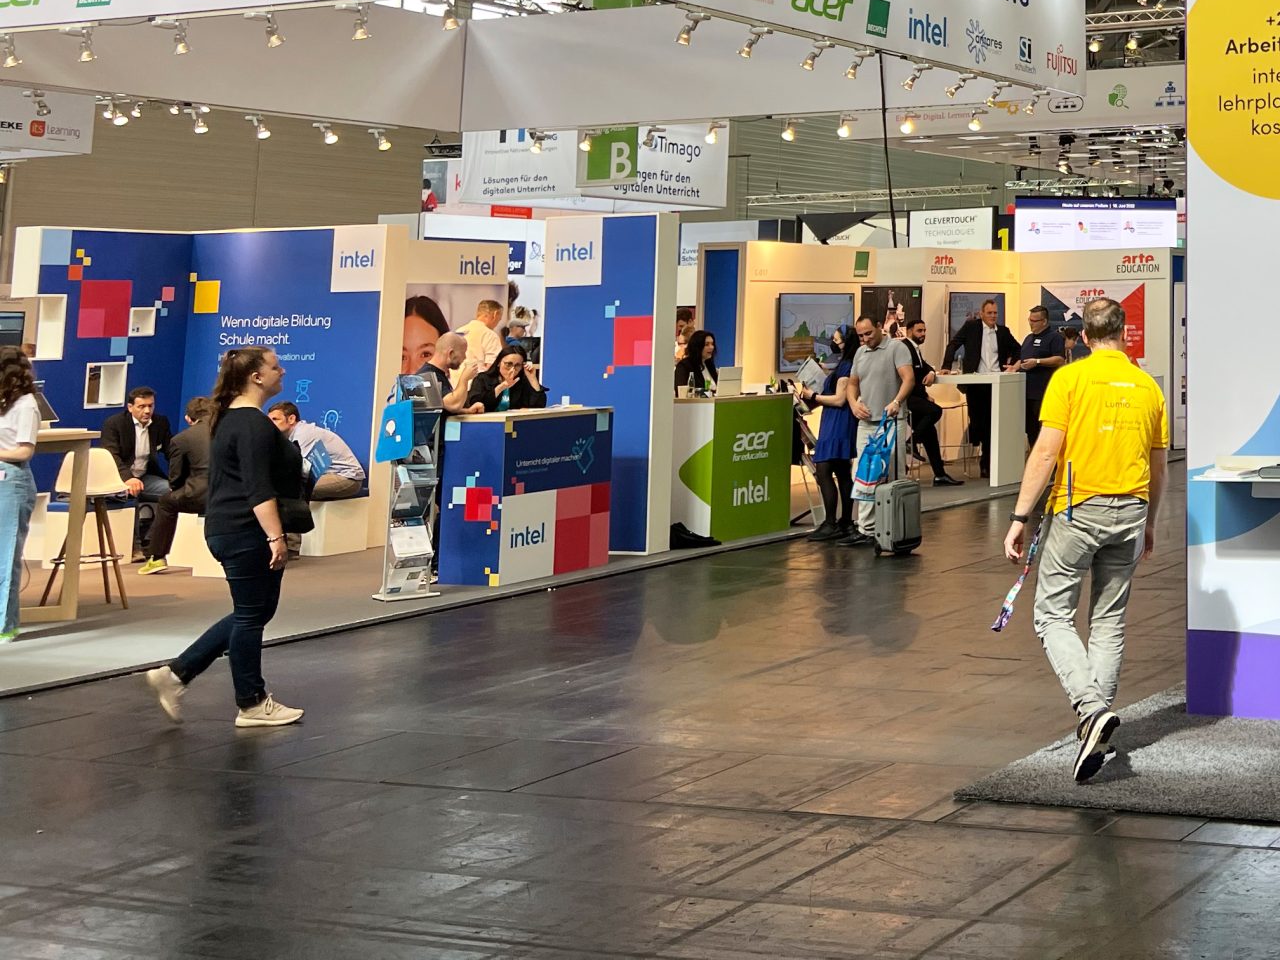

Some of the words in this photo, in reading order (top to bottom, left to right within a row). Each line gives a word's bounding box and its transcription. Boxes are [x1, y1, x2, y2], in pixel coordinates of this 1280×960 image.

[908, 8, 947, 47] intel
[1046, 45, 1077, 77] FUJITSU
[0, 121, 23, 130] EKE
[657, 135, 701, 163] Timago
[610, 141, 632, 180] B
[483, 176, 518, 185] Lösungen
[520, 174, 532, 182] für
[533, 174, 548, 182] den
[660, 170, 673, 182] für
[675, 172, 691, 183] den
[482, 186, 516, 196] digitalen
[517, 184, 556, 193] Unterricht
[656, 184, 700, 198] Unterricht
[924, 216, 976, 225] CLEVERTOUCH
[339, 248, 374, 269] intel
[556, 241, 593, 262] intel
[1122, 253, 1155, 264] arte
[460, 254, 495, 276] intel
[930, 265, 957, 275] EDUCATION
[1116, 263, 1160, 274] EDUCATION
[221, 315, 251, 328] Wenn
[252, 315, 289, 330] digitale
[291, 314, 332, 329] Bildung
[219, 333, 255, 346] Schule
[301, 352, 316, 361] und
[732, 430, 774, 452] acer
[733, 475, 768, 507] intel
[510, 522, 545, 548] intel
